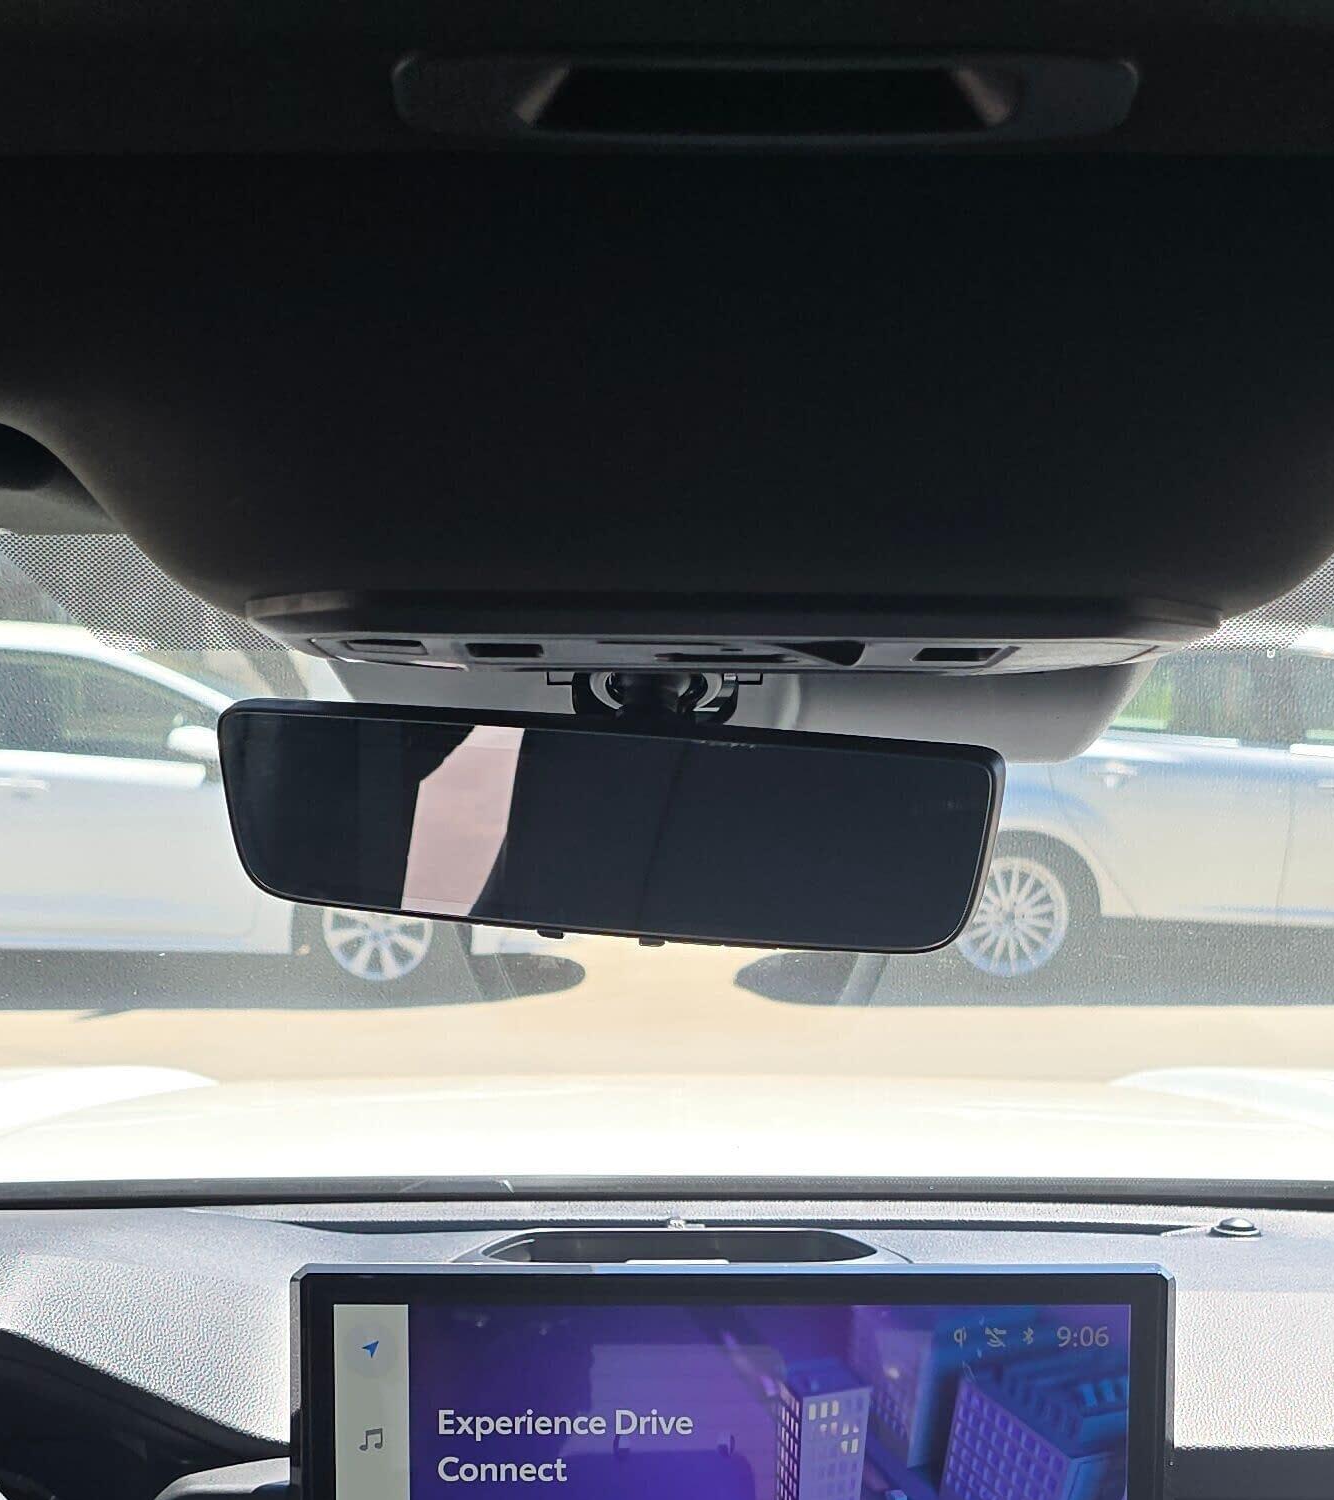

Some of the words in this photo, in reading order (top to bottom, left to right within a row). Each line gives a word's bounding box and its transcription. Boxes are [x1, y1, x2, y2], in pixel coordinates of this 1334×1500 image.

[1056, 1325, 1110, 1348] 9:06
[437, 1408, 607, 1442] Experience
[615, 1408, 694, 1435] Drive
[436, 1455, 568, 1482] Connect
